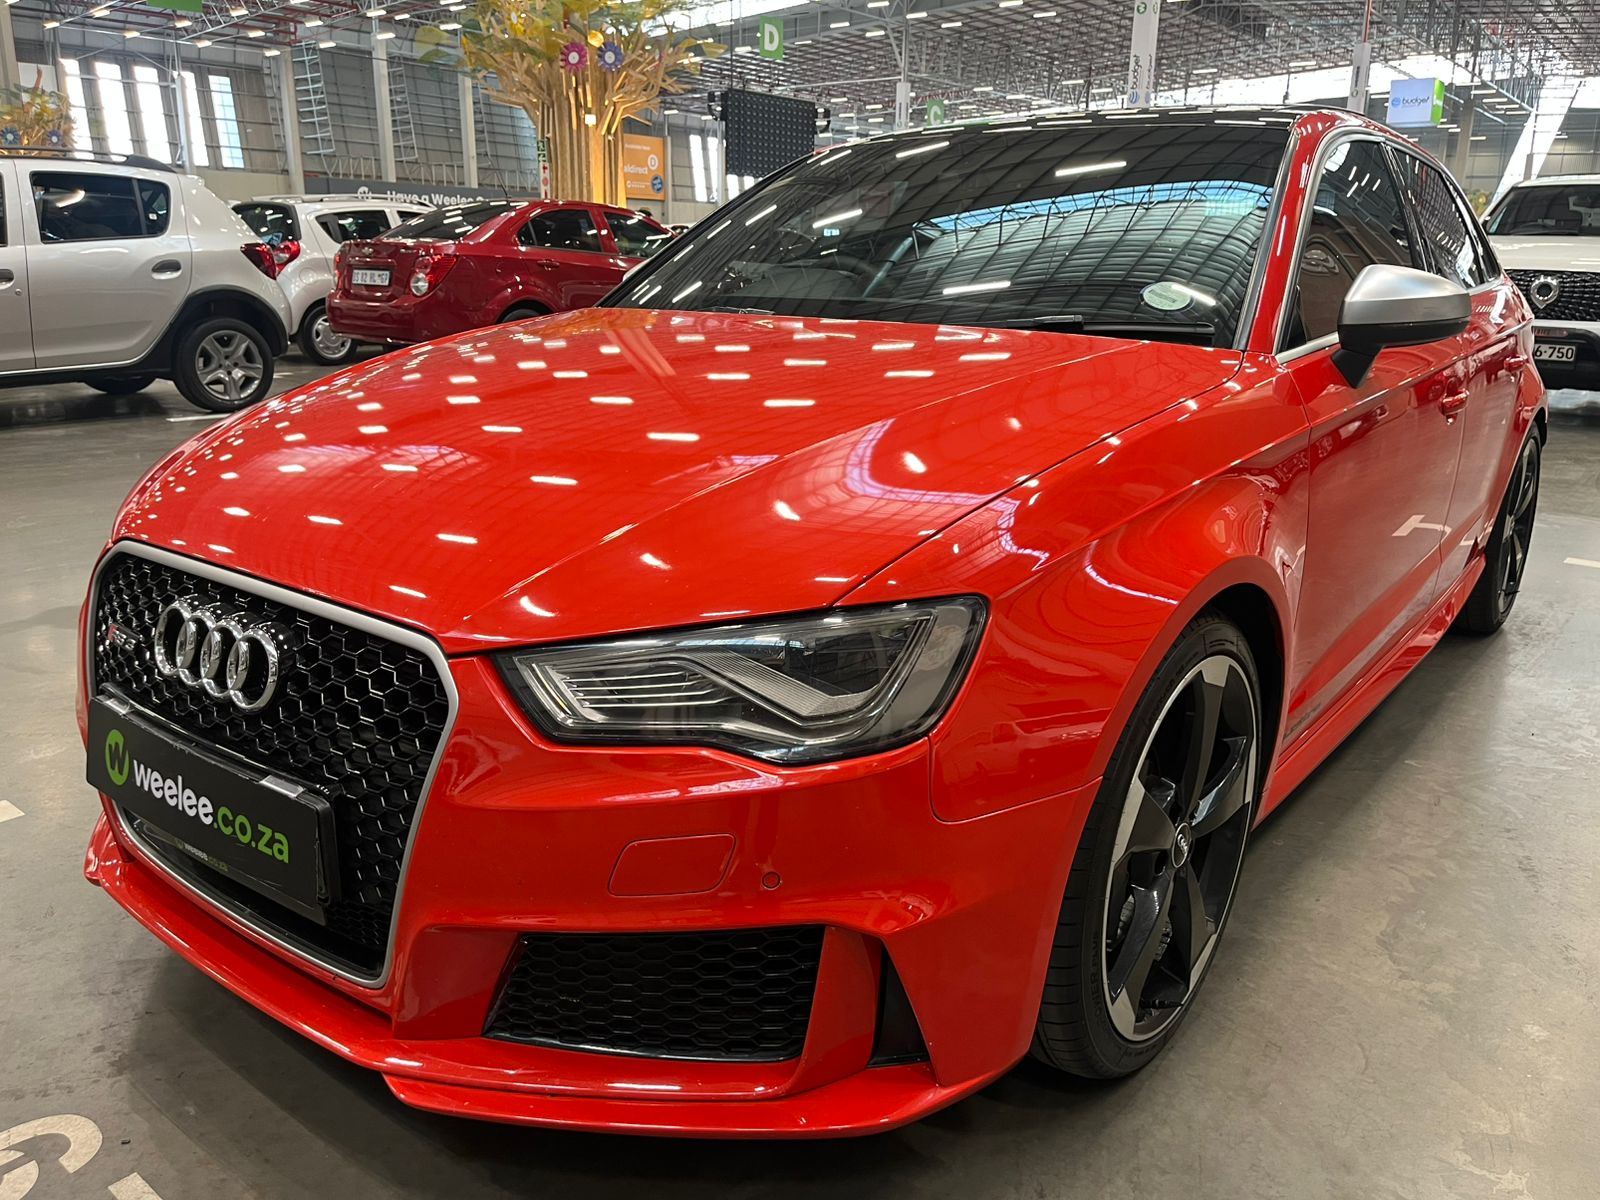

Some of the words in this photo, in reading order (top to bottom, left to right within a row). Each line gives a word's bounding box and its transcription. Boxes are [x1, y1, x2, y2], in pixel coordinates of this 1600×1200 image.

[764, 23, 779, 51] D
[1402, 96, 1429, 107] budget
[930, 105, 942, 126] C
[133, 759, 289, 864] weelee.co.za
